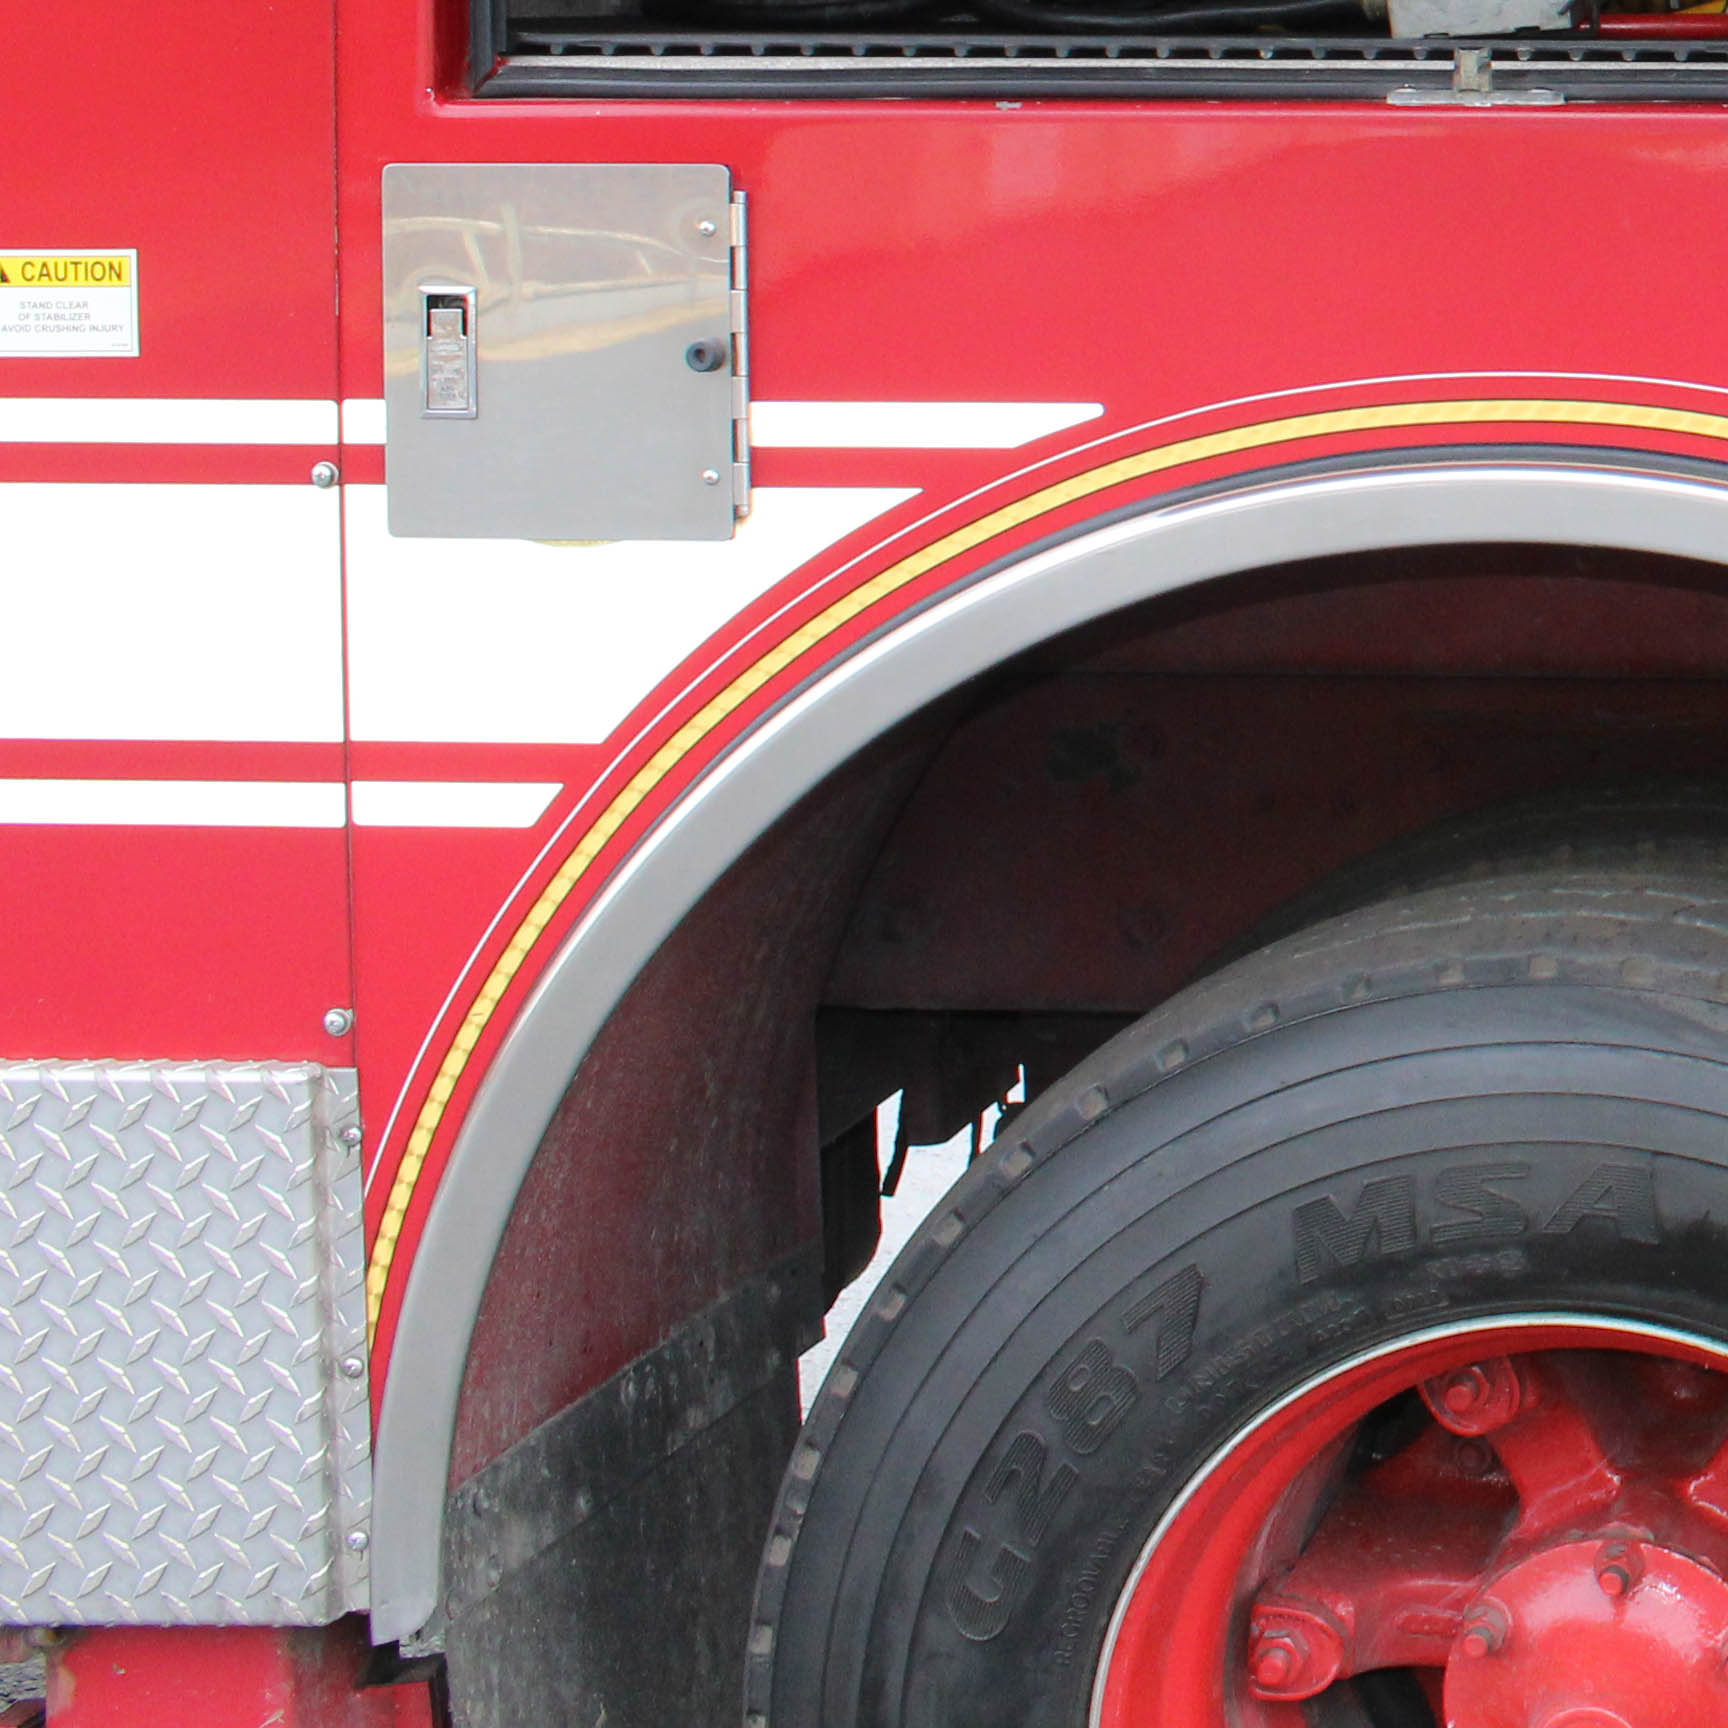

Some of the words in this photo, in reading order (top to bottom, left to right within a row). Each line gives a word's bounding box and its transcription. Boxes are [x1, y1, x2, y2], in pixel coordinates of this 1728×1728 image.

[21, 260, 123, 282] CAUTION
[19, 301, 53, 310] STAND
[55, 301, 89, 310] CLEAR
[18, 313, 31, 321] OF
[34, 313, 91, 322] STABILIZER
[1, 324, 32, 333] AVOID
[34, 324, 87, 333] CRUSHING
[89, 324, 124, 333] INJURY
[943, 1265, 1207, 1642] G287
[1294, 1161, 1663, 1285] MSA
